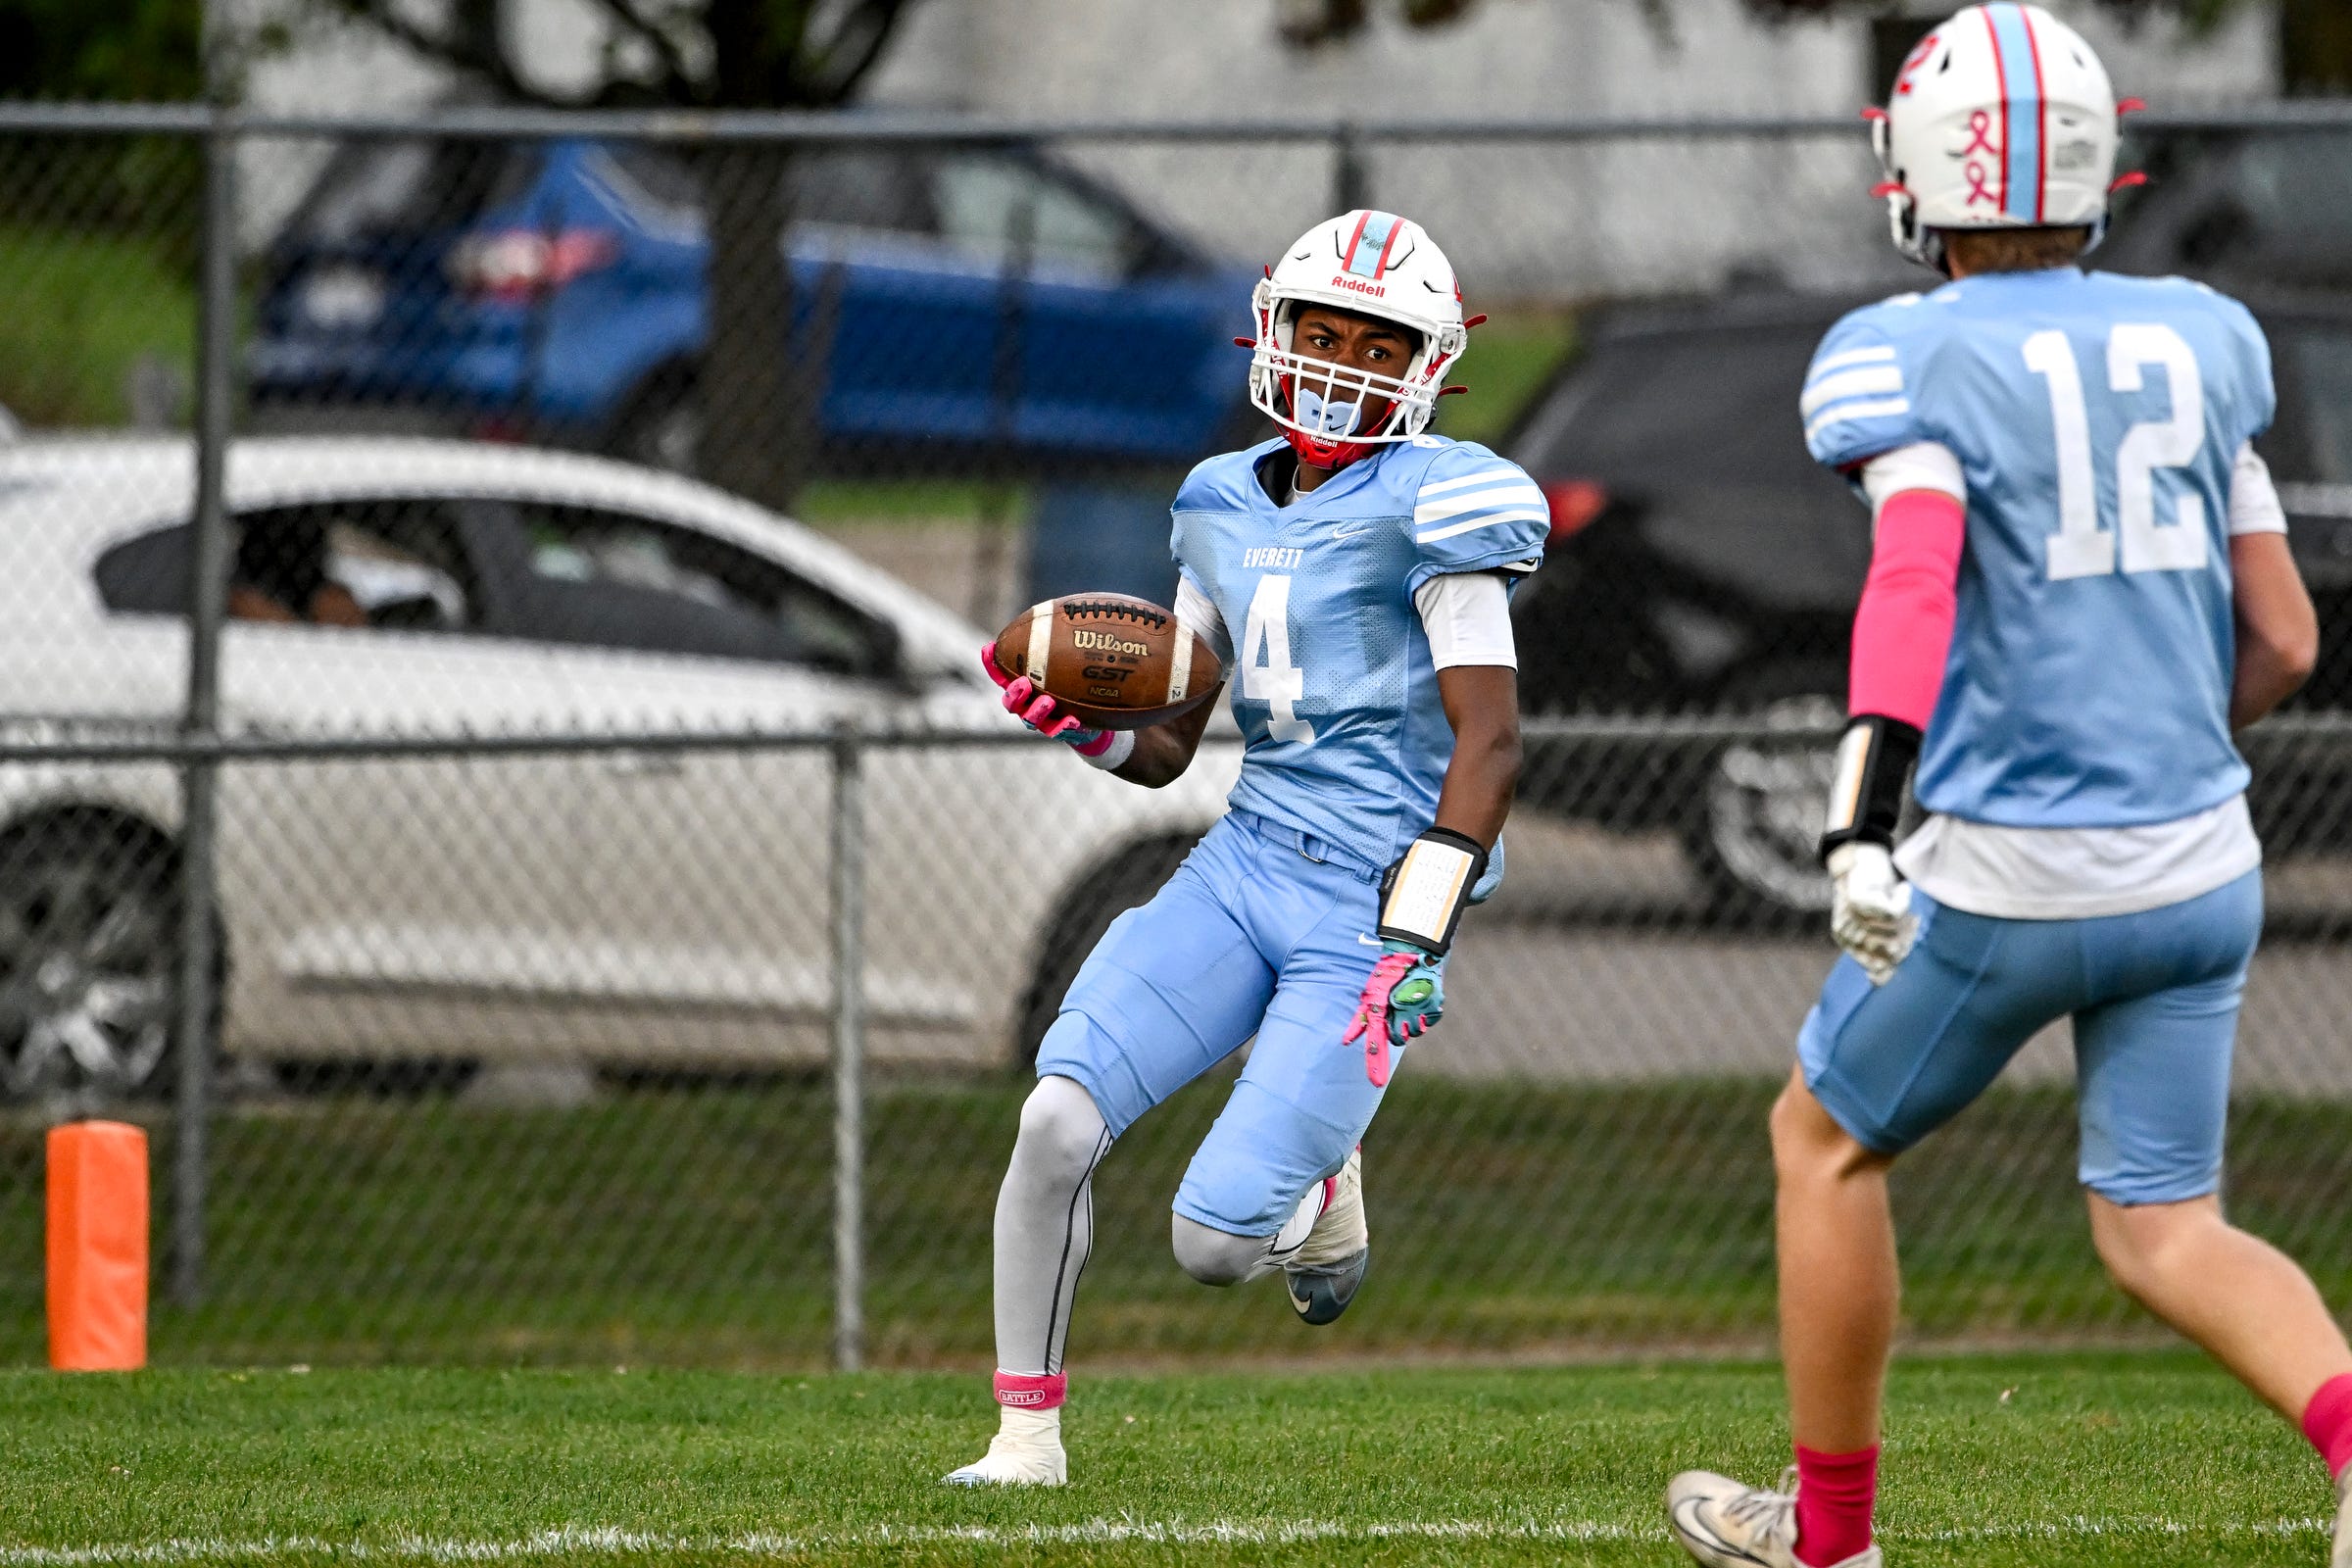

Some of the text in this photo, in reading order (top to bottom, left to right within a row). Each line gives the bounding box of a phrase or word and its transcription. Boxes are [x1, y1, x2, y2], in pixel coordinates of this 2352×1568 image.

[1332, 276, 1385, 298] Riddell
[2022, 324, 2208, 580] 12
[1243, 547, 1303, 568] EVERETT
[1073, 630, 1148, 656] Wilson
[1242, 574, 1314, 745] 4
[1082, 665, 1135, 682] GST
[1089, 686, 1119, 697] NCAA
[1002, 1393, 1041, 1402] BATTLE
